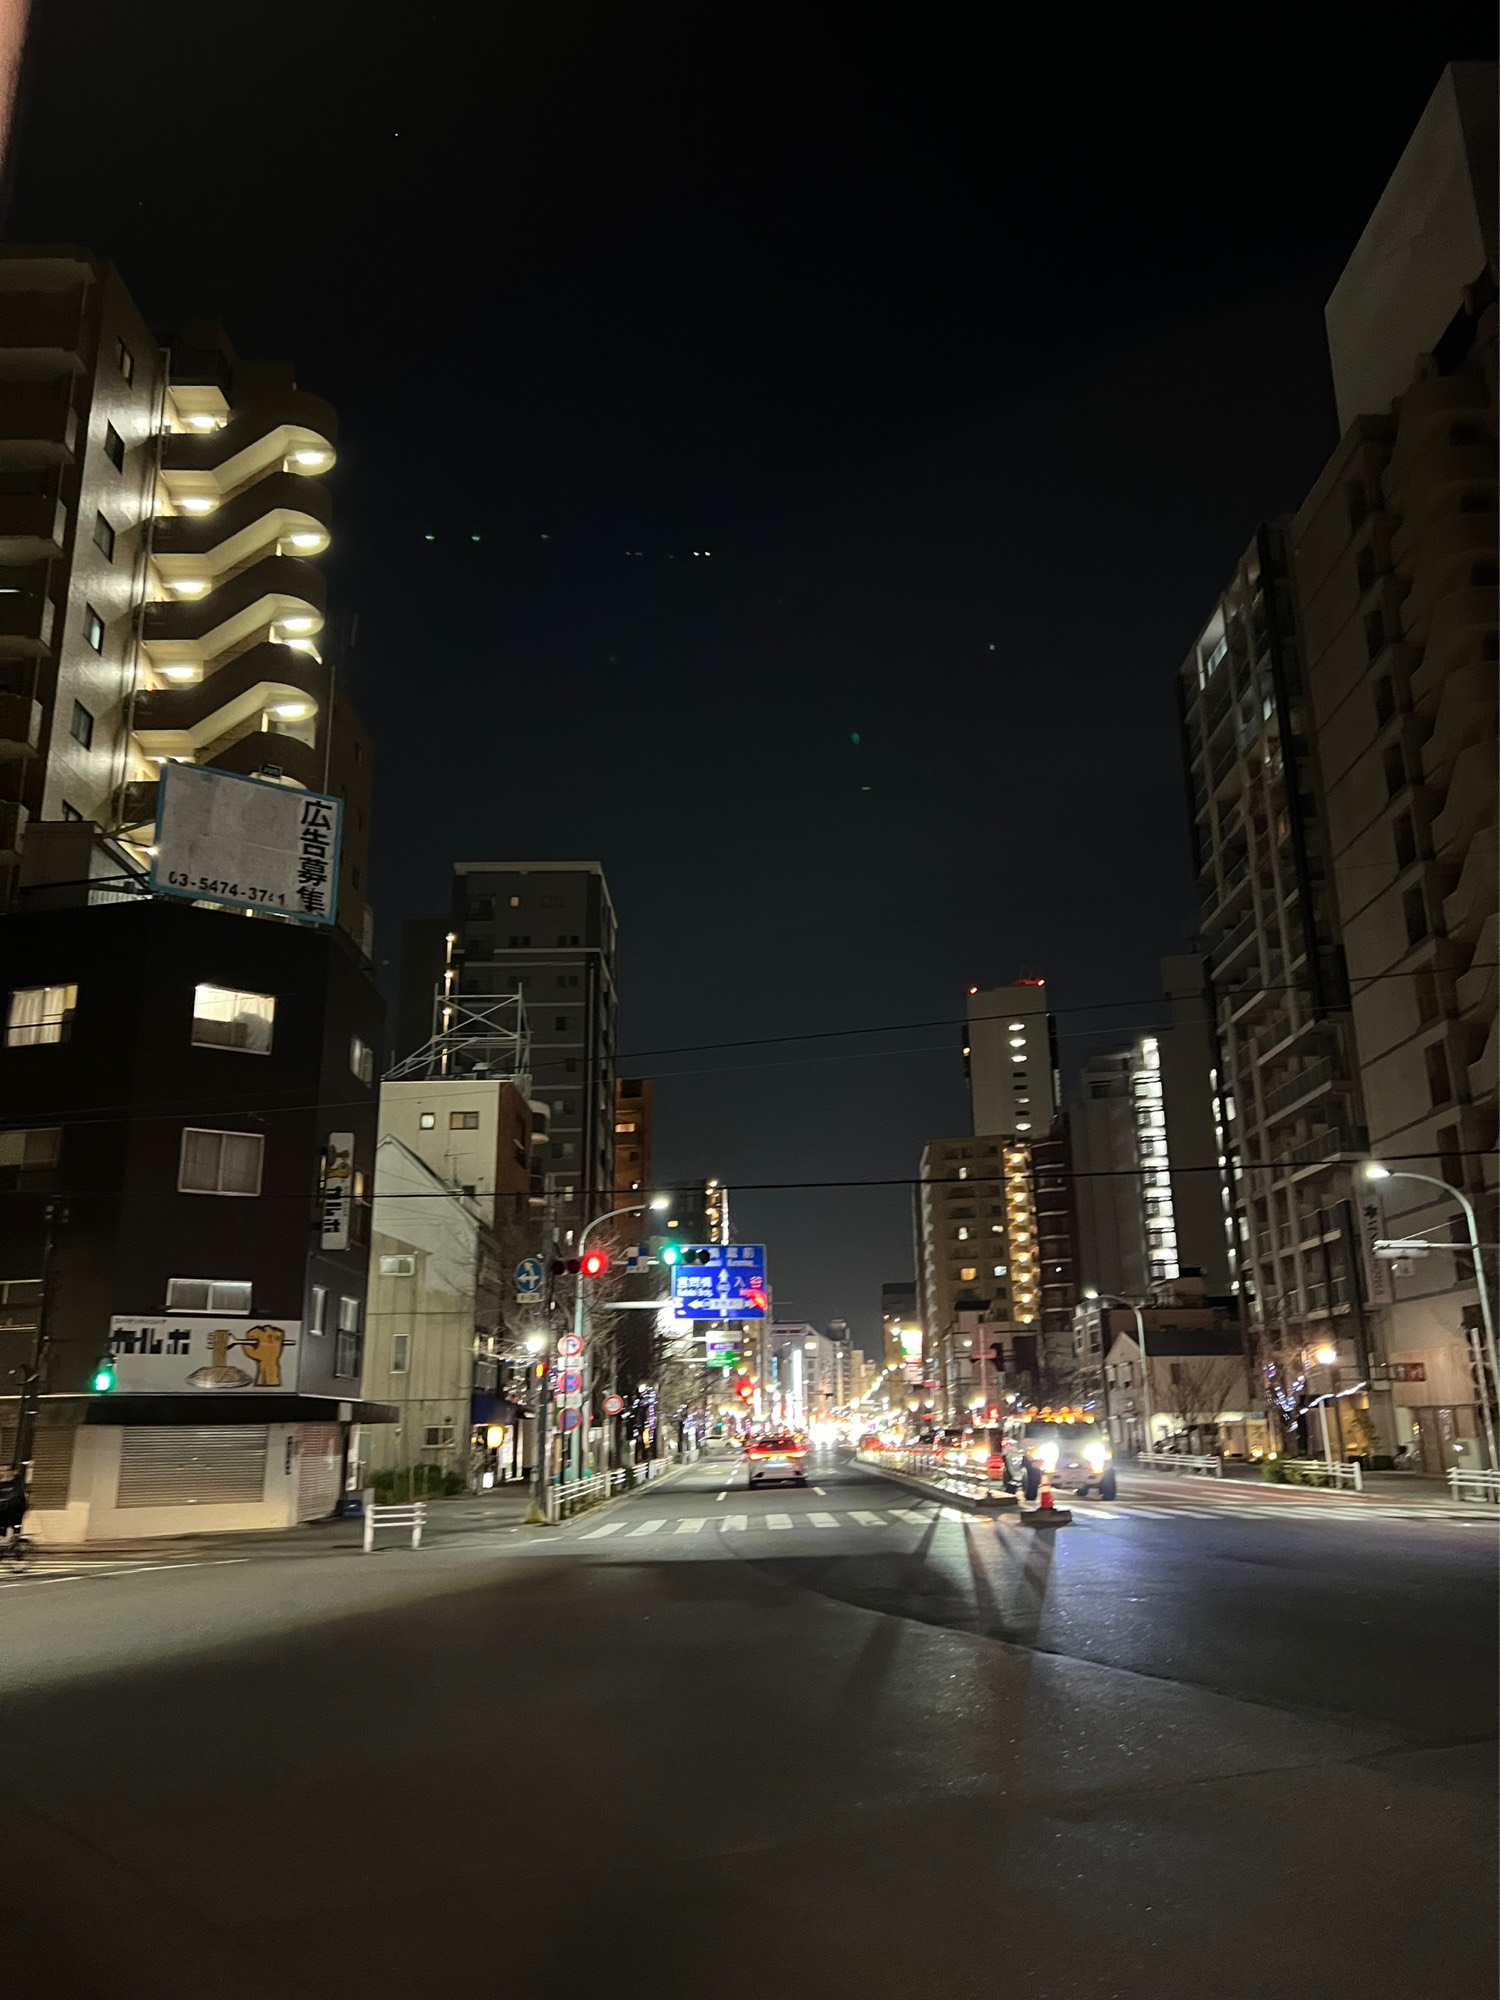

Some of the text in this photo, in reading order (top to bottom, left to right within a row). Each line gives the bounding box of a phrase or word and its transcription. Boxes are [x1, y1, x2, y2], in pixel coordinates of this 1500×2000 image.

[297, 799, 332, 918] 広告募集
[109, 1327, 192, 1355] カルボ
